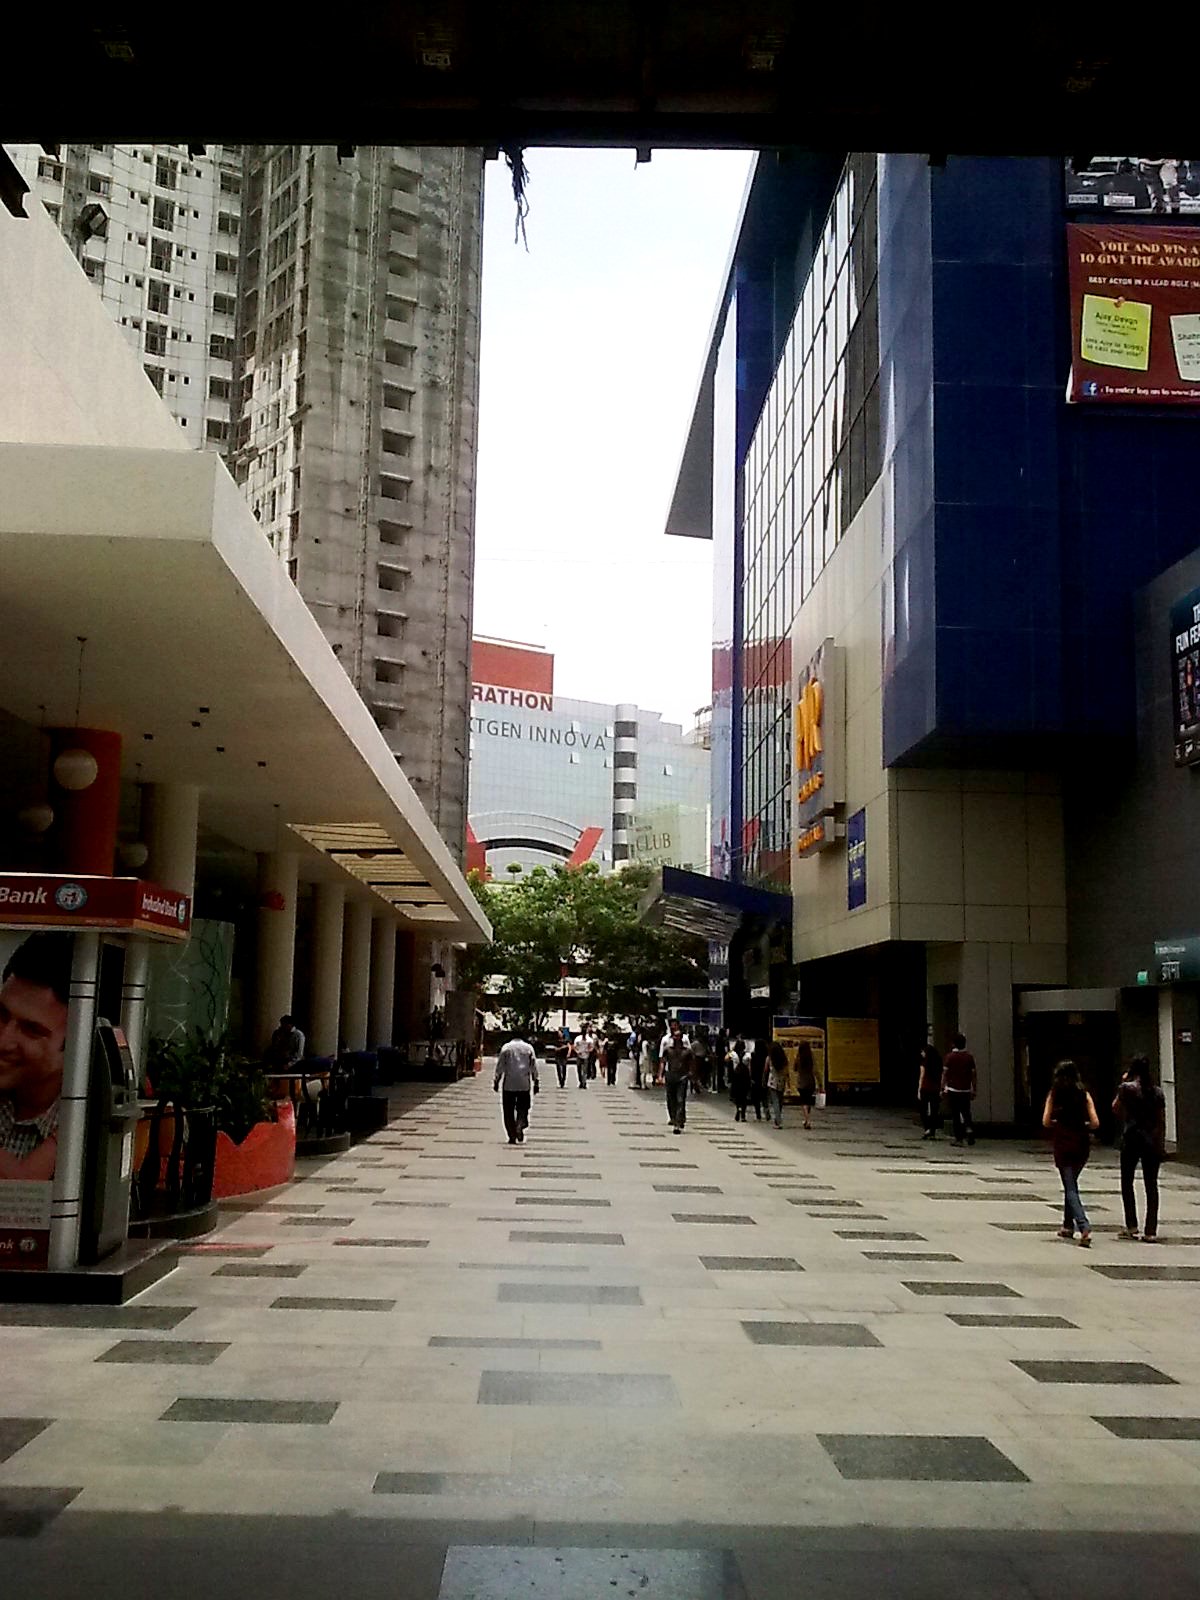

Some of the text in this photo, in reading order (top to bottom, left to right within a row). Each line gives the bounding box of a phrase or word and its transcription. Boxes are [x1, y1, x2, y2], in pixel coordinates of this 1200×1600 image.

[1099, 241, 1199, 255] VOTE AND WIN A
[1080, 253, 1095, 263] TO
[1097, 254, 1125, 265] GIVE
[1130, 255, 1155, 266] THE
[1088, 276, 1107, 284] BEST
[1109, 277, 1133, 285] ACTOR
[1134, 278, 1143, 286] IN
[1151, 279, 1170, 287] LEAD
[1170, 280, 1189, 288] ROLE
[1095, 312, 1112, 321] Ajay
[1105, 386, 1114, 394] To
[1136, 387, 1149, 396] log
[529, 725, 606, 751] INNOVA
[636, 832, 671, 852] CLUB
[0, 886, 48, 904] Bank
